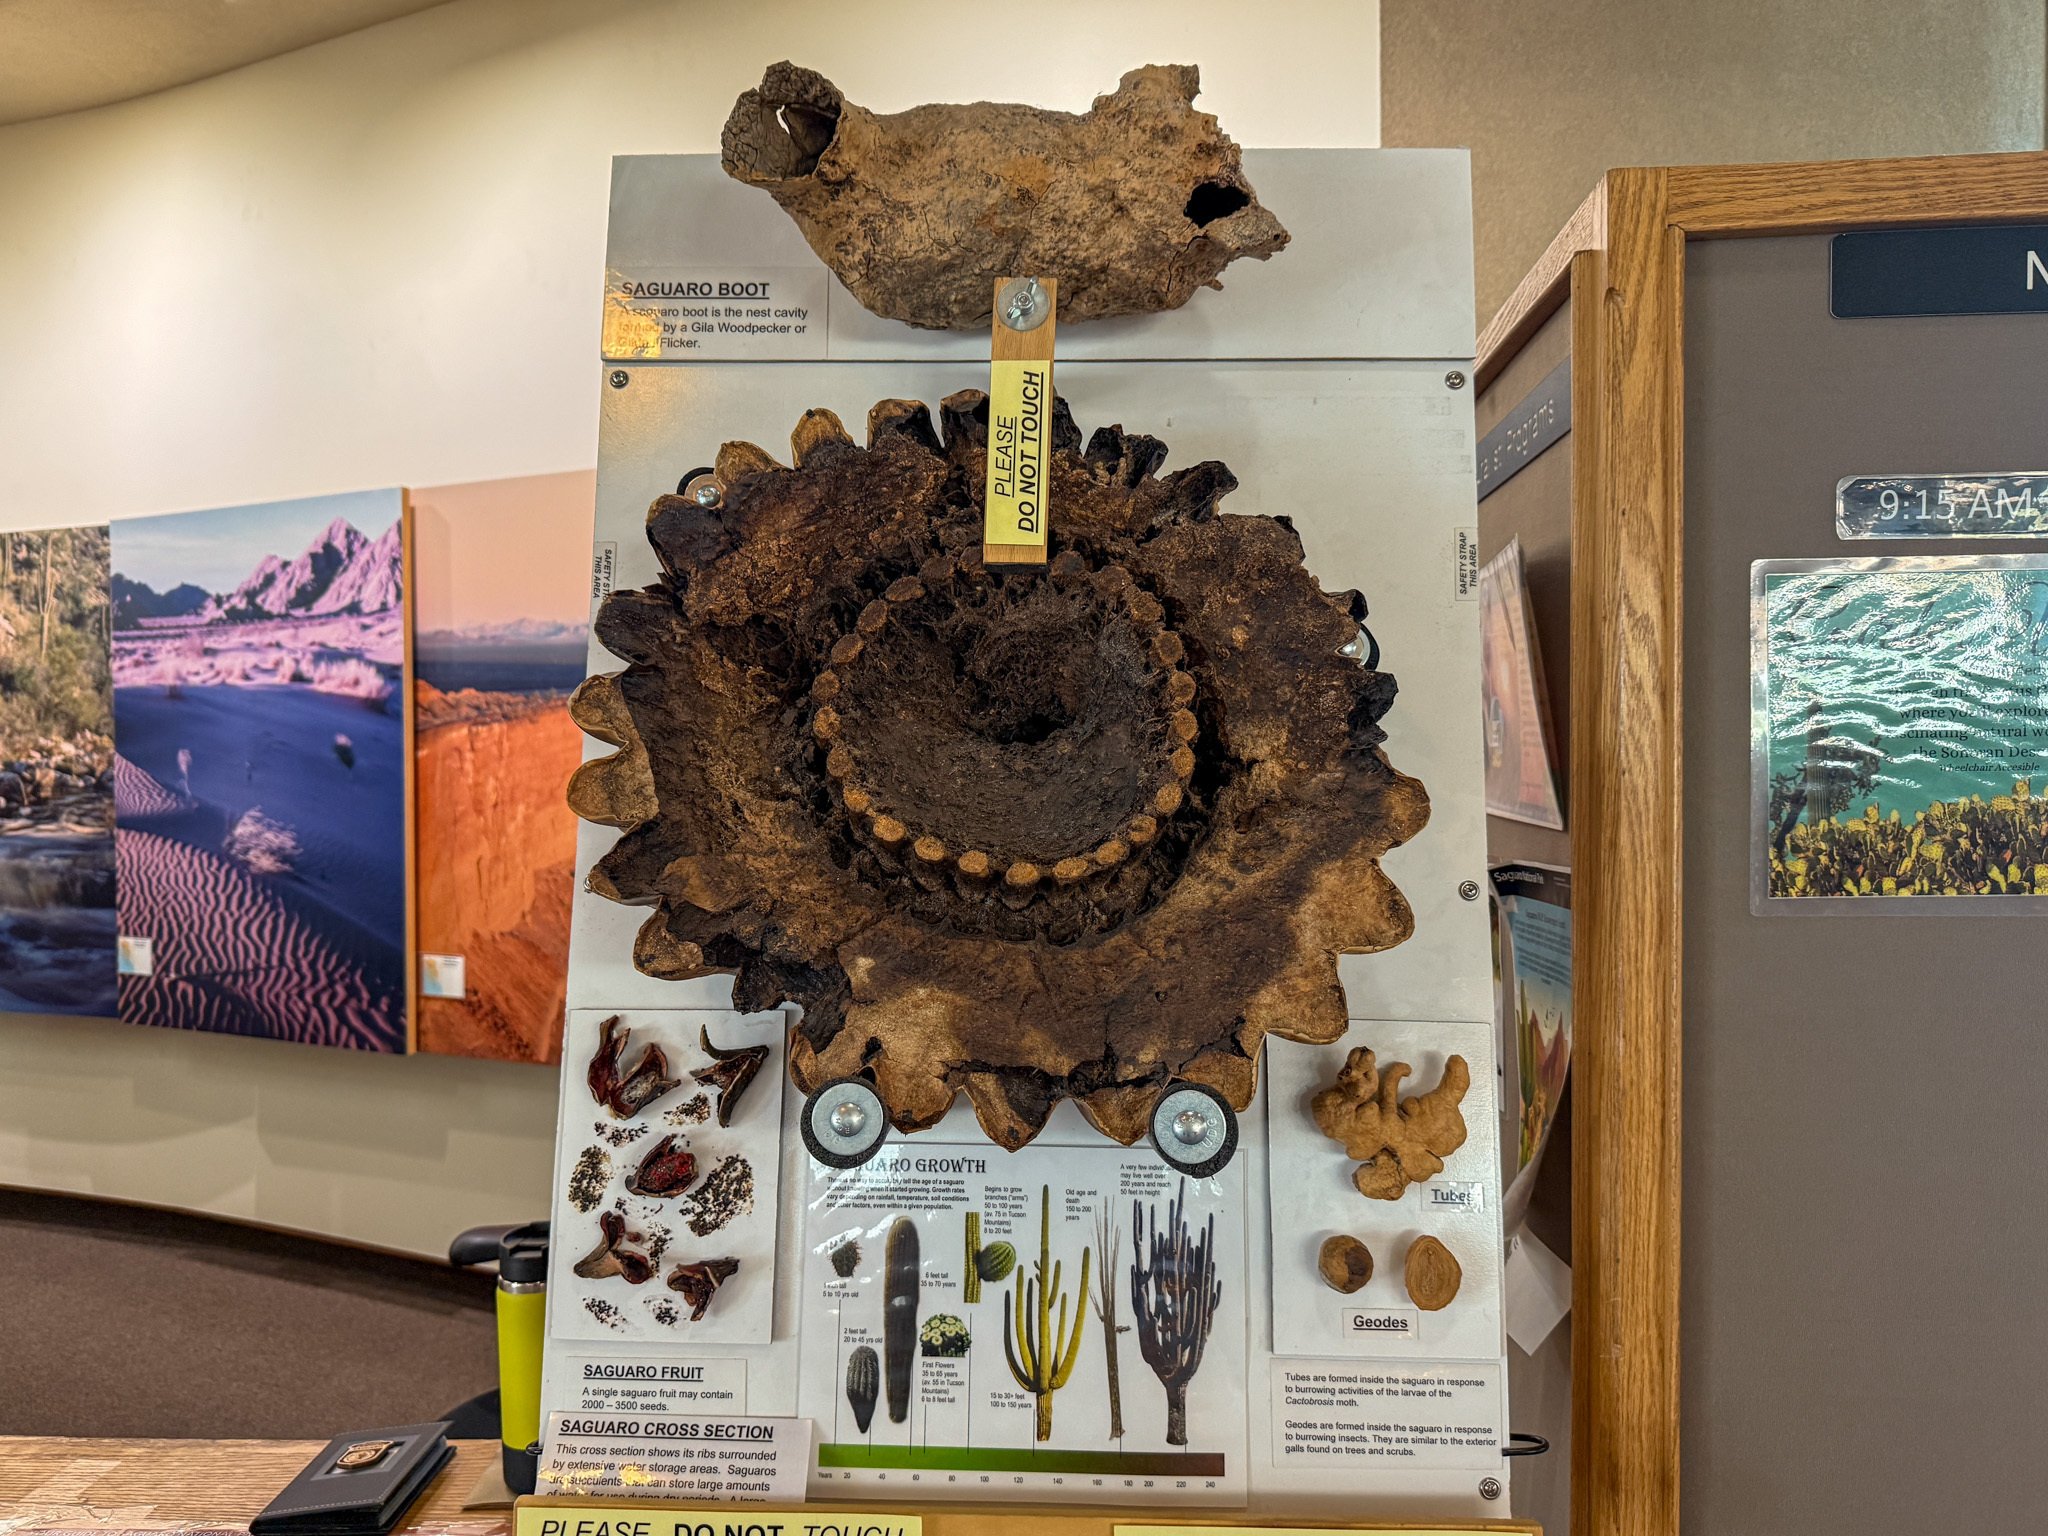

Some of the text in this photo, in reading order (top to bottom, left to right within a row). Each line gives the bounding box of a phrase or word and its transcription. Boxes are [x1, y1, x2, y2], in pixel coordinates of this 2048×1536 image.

[622, 282, 770, 296] SAGUARO BOOT
[683, 307, 707, 317] boot
[711, 307, 721, 317] is
[724, 307, 742, 317] the
[746, 308, 771, 318] nest
[774, 308, 808, 319] cavity
[663, 323, 676, 334] by
[691, 323, 714, 332] Gila
[718, 323, 790, 334] Woodpecker
[794, 325, 806, 333] or
[660, 338, 700, 348] Flicker.
[995, 415, 1014, 497] PLEASE
[1018, 371, 1040, 532] DO NOT TOUCH
[1880, 488, 2032, 520] 9:15 AM
[604, 548, 612, 582] SAFETY
[593, 576, 601, 598] AREA
[916, 1157, 986, 1173] GROWTH
[1431, 1189, 1473, 1201] Tubes
[1353, 1315, 1408, 1328] Geodes
[584, 1365, 704, 1379] SAGUARO FRUIT
[1285, 1373, 1310, 1382] Tubes
[1328, 1374, 1357, 1383] formed
[1360, 1375, 1384, 1383] inside
[1386, 1376, 1399, 1384] the
[1402, 1378, 1434, 1387] saguaro
[1447, 1379, 1484, 1387] response
[582, 1387, 732, 1400] A single saguaro fruit may contain
[1296, 1386, 1335, 1395] burrowing
[1338, 1387, 1373, 1395] activities
[1376, 1387, 1384, 1395] of
[1386, 1388, 1399, 1396] the
[1401, 1389, 1426, 1397] larvae
[1429, 1389, 1437, 1397] of
[1439, 1389, 1452, 1398] the
[582, 1400, 604, 1409] 2000
[615, 1401, 637, 1410] 3500
[640, 1400, 669, 1411] seeds.
[1286, 1397, 1359, 1406] Cactobrosis moth.
[560, 1419, 773, 1439] SAGUARO CROSS SECTION
[1285, 1420, 1317, 1429] Geodes
[1320, 1422, 1333, 1430] are
[1336, 1421, 1364, 1430] formed
[1367, 1423, 1391, 1431] inside
[1394, 1424, 1406, 1432] the
[1409, 1426, 1442, 1434] saguaro
[1454, 1427, 1492, 1435] response
[1285, 1433, 1293, 1441] to
[1296, 1433, 1336, 1443] burrowing
[1338, 1434, 1369, 1443] insects.
[1372, 1435, 1393, 1445] They
[1411, 1436, 1437, 1445] similar
[1440, 1437, 1448, 1445] to
[1465, 1438, 1496, 1447] exterior
[556, 1443, 776, 1461] This cross section shows its ribs surrounded
[1285, 1445, 1304, 1454] galls
[1307, 1445, 1330, 1453] found
[1368, 1447, 1384, 1455] and
[1386, 1447, 1415, 1456] scrubs.
[553, 1459, 565, 1470] by
[567, 1461, 615, 1470] extensive
[649, 1462, 686, 1474] storage
[690, 1466, 720, 1474] areas.
[728, 1465, 776, 1477] Saguaros
[668, 1479, 694, 1488] store
[698, 1479, 723, 1491] large
[726, 1482, 770, 1491] amounts
